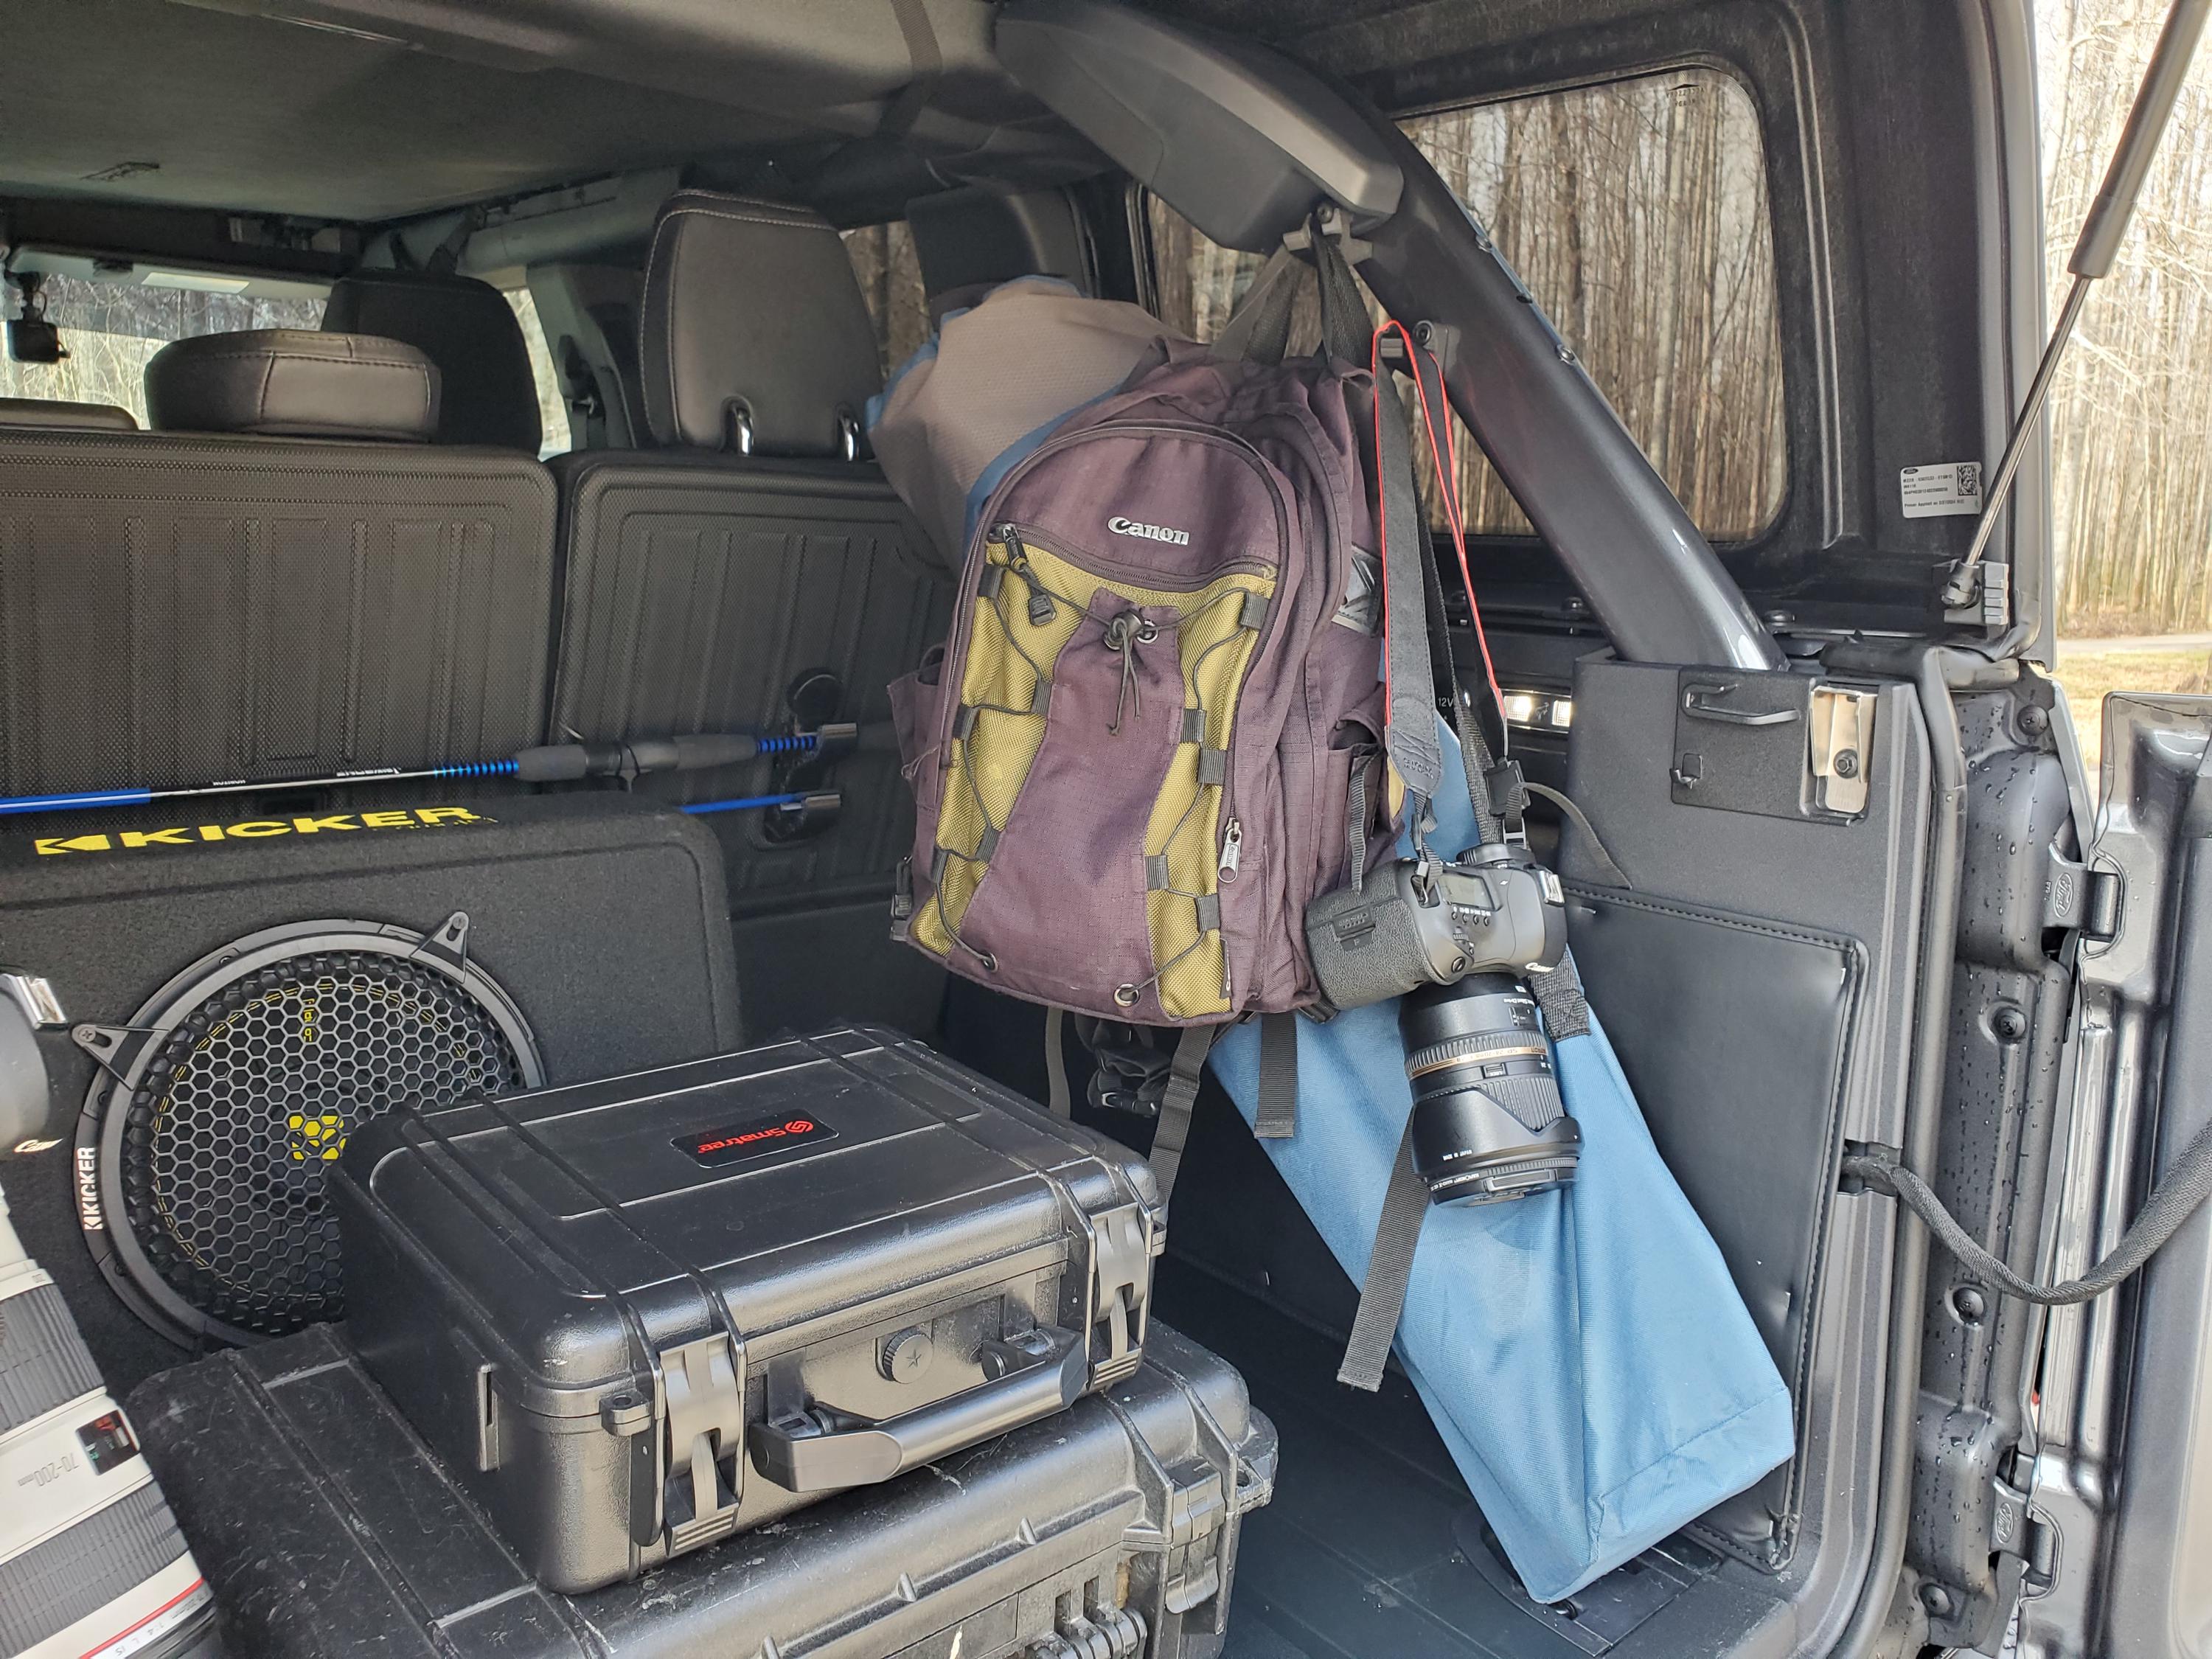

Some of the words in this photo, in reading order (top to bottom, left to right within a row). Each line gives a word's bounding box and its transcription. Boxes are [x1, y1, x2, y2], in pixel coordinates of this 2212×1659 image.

[1107, 516, 1190, 546] Canon
[1438, 697, 1454, 707] 12V
[119, 807, 481, 847] KICKER
[2056, 879, 2071, 911] Ford
[697, 1127, 787, 1154] Smatree
[77, 1147, 101, 1215] KICKER
[1997, 1508, 2012, 1538] Ford
